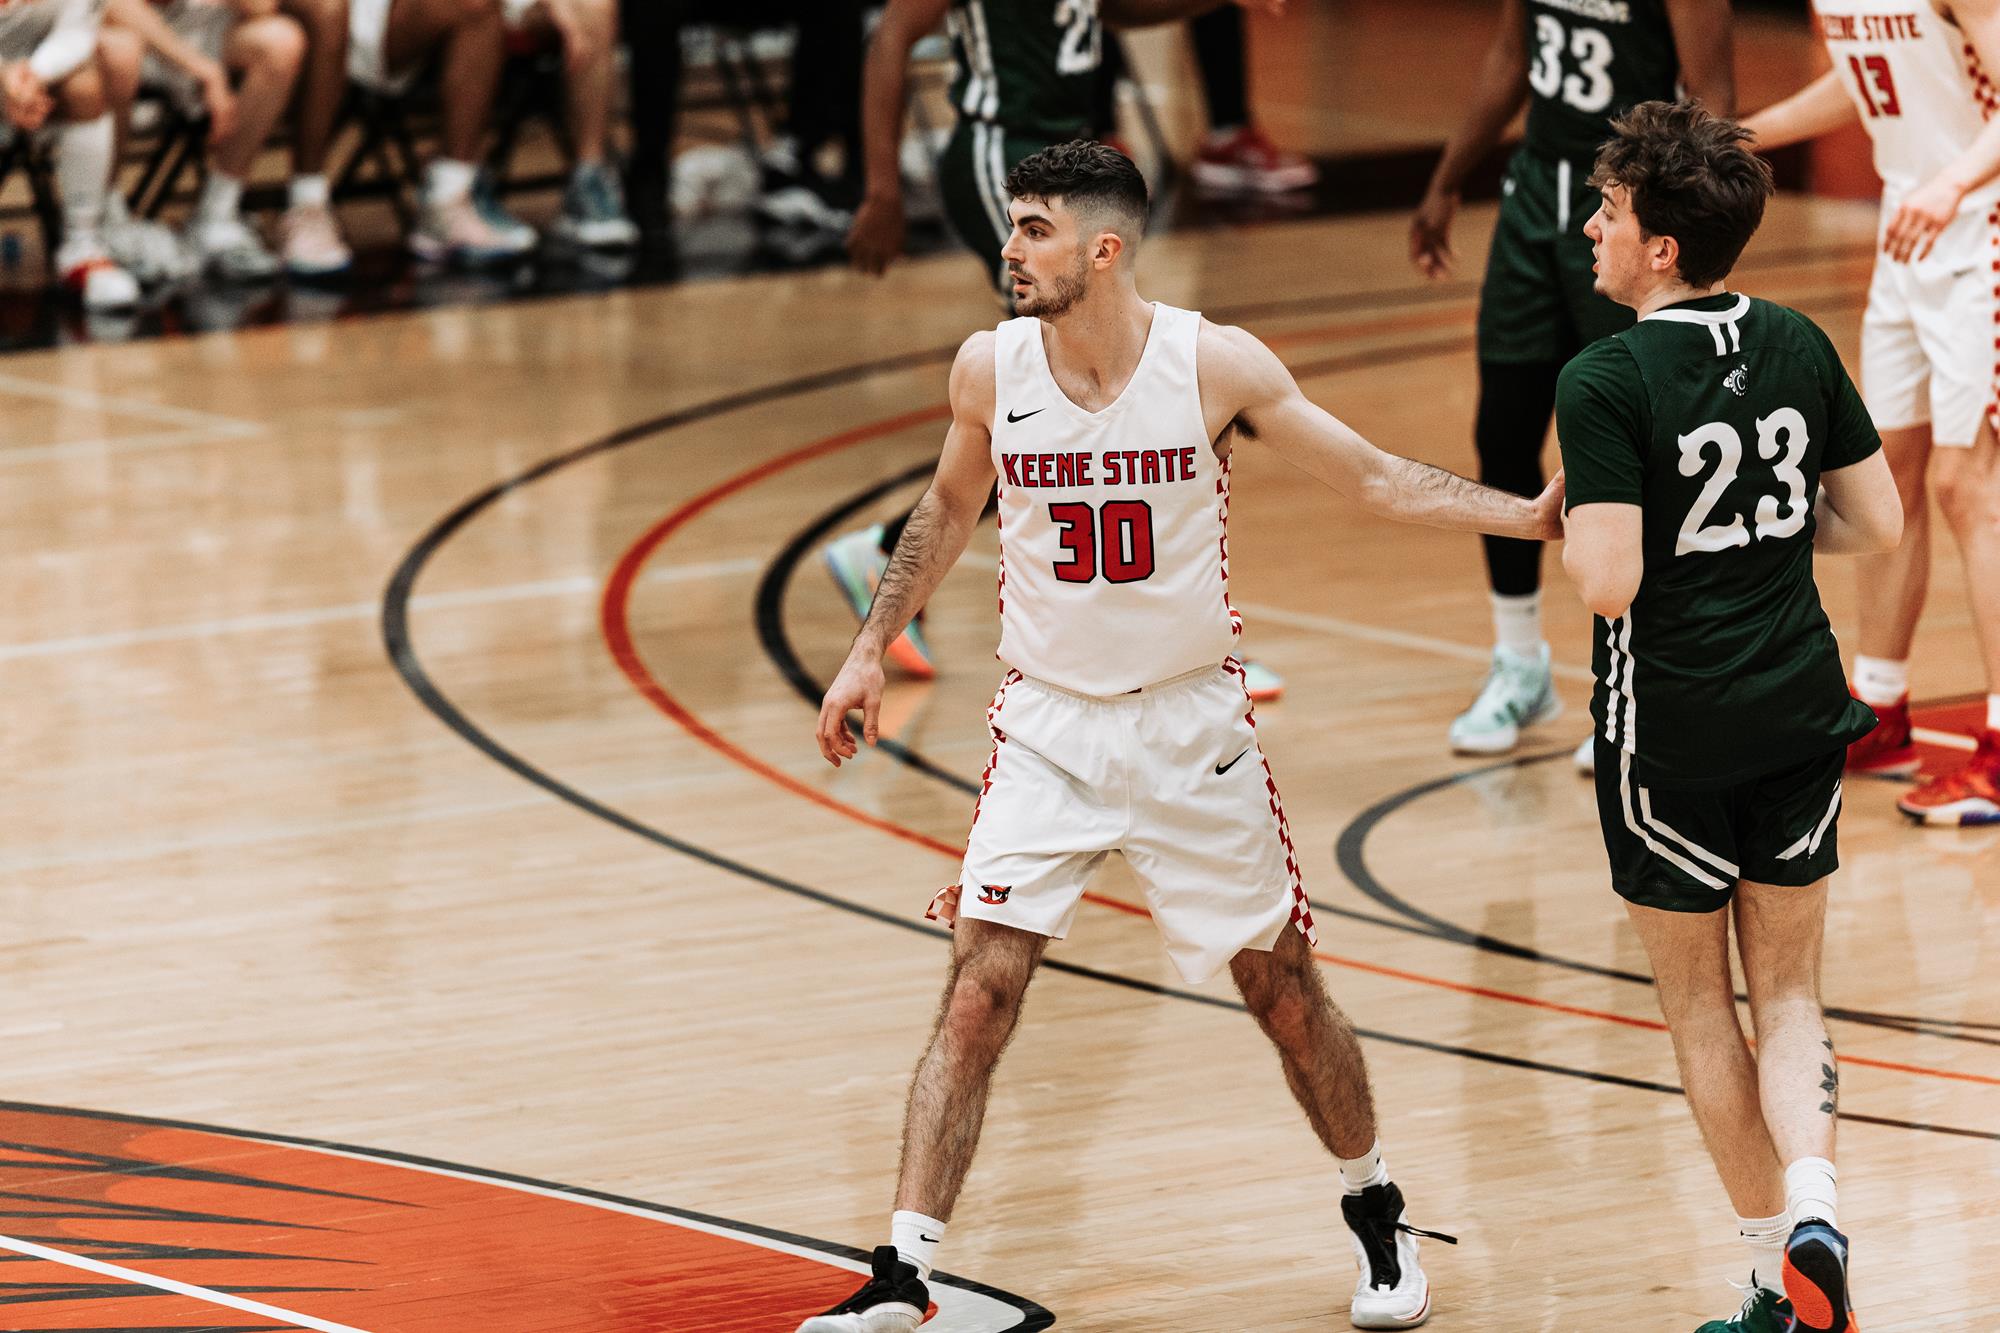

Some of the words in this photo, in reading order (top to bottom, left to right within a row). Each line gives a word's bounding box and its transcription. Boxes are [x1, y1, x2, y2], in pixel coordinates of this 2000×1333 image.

[1529, 14, 1614, 113] 33
[1848, 55, 1901, 117] 13
[1002, 452, 1094, 488] KEENE
[1103, 446, 1196, 486] STATE
[1675, 407, 1810, 557] 23
[1048, 499, 1155, 584] 30
